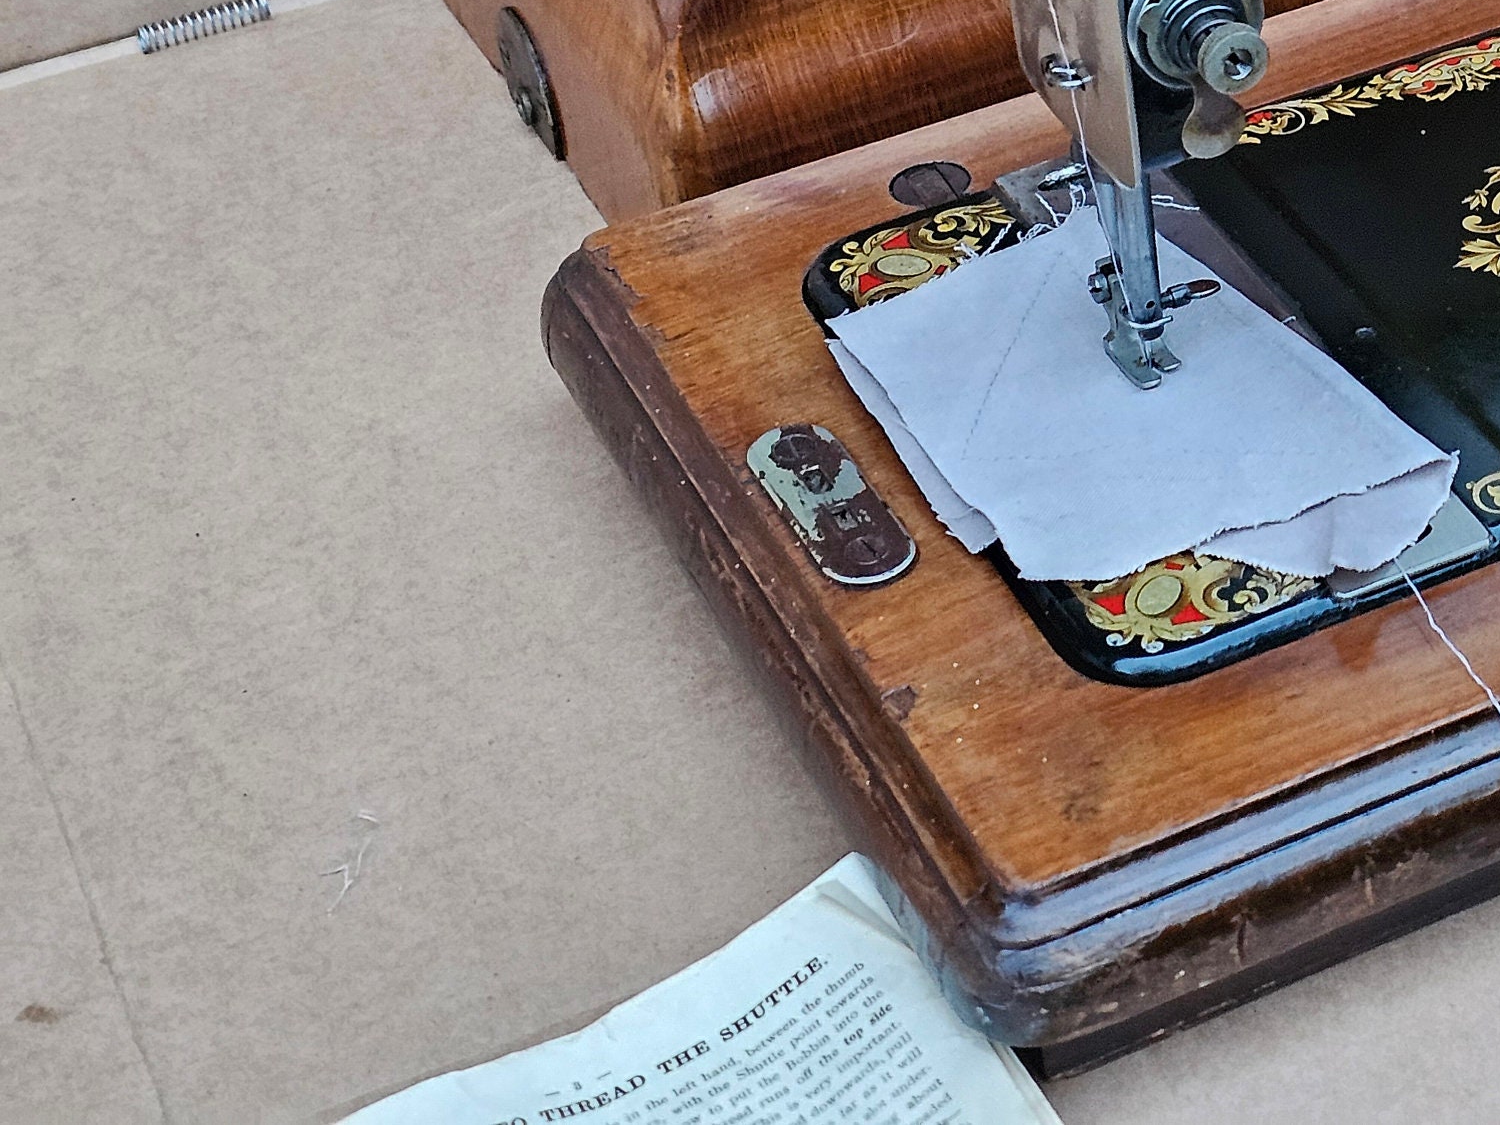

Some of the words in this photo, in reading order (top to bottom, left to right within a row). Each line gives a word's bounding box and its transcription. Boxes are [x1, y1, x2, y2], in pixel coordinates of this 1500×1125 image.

[539, 1073, 647, 1123] THREAD
[656, 1039, 711, 1075] THE
[719, 956, 829, 1043] SHUTTLE.
[645, 1096, 669, 1112] the
[672, 1079, 698, 1097] left
[744, 1016, 799, 1058] between
[801, 996, 822, 1016] the
[824, 961, 865, 997] thumb
[672, 1096, 703, 1115] with
[707, 1081, 731, 1097] the
[736, 1049, 786, 1081] Shuttle
[788, 1018, 823, 1050] point
[825, 974, 875, 1019] towards
[707, 1103, 724, 1116] to
[728, 1087, 753, 1108] put
[757, 1072, 781, 1089] the
[785, 1032, 832, 1073] Bobbin
[834, 1011, 859, 1034] into
[862, 988, 885, 1010] the
[796, 1066, 814, 1086] off
[818, 1047, 840, 1069] the
[843, 1026, 865, 1047] top
[869, 1002, 893, 1026] side
[886, 1030, 913, 1059] pull
[897, 1045, 923, 1069] will
[804, 1074, 832, 1100] very
[906, 1077, 944, 1110] about
